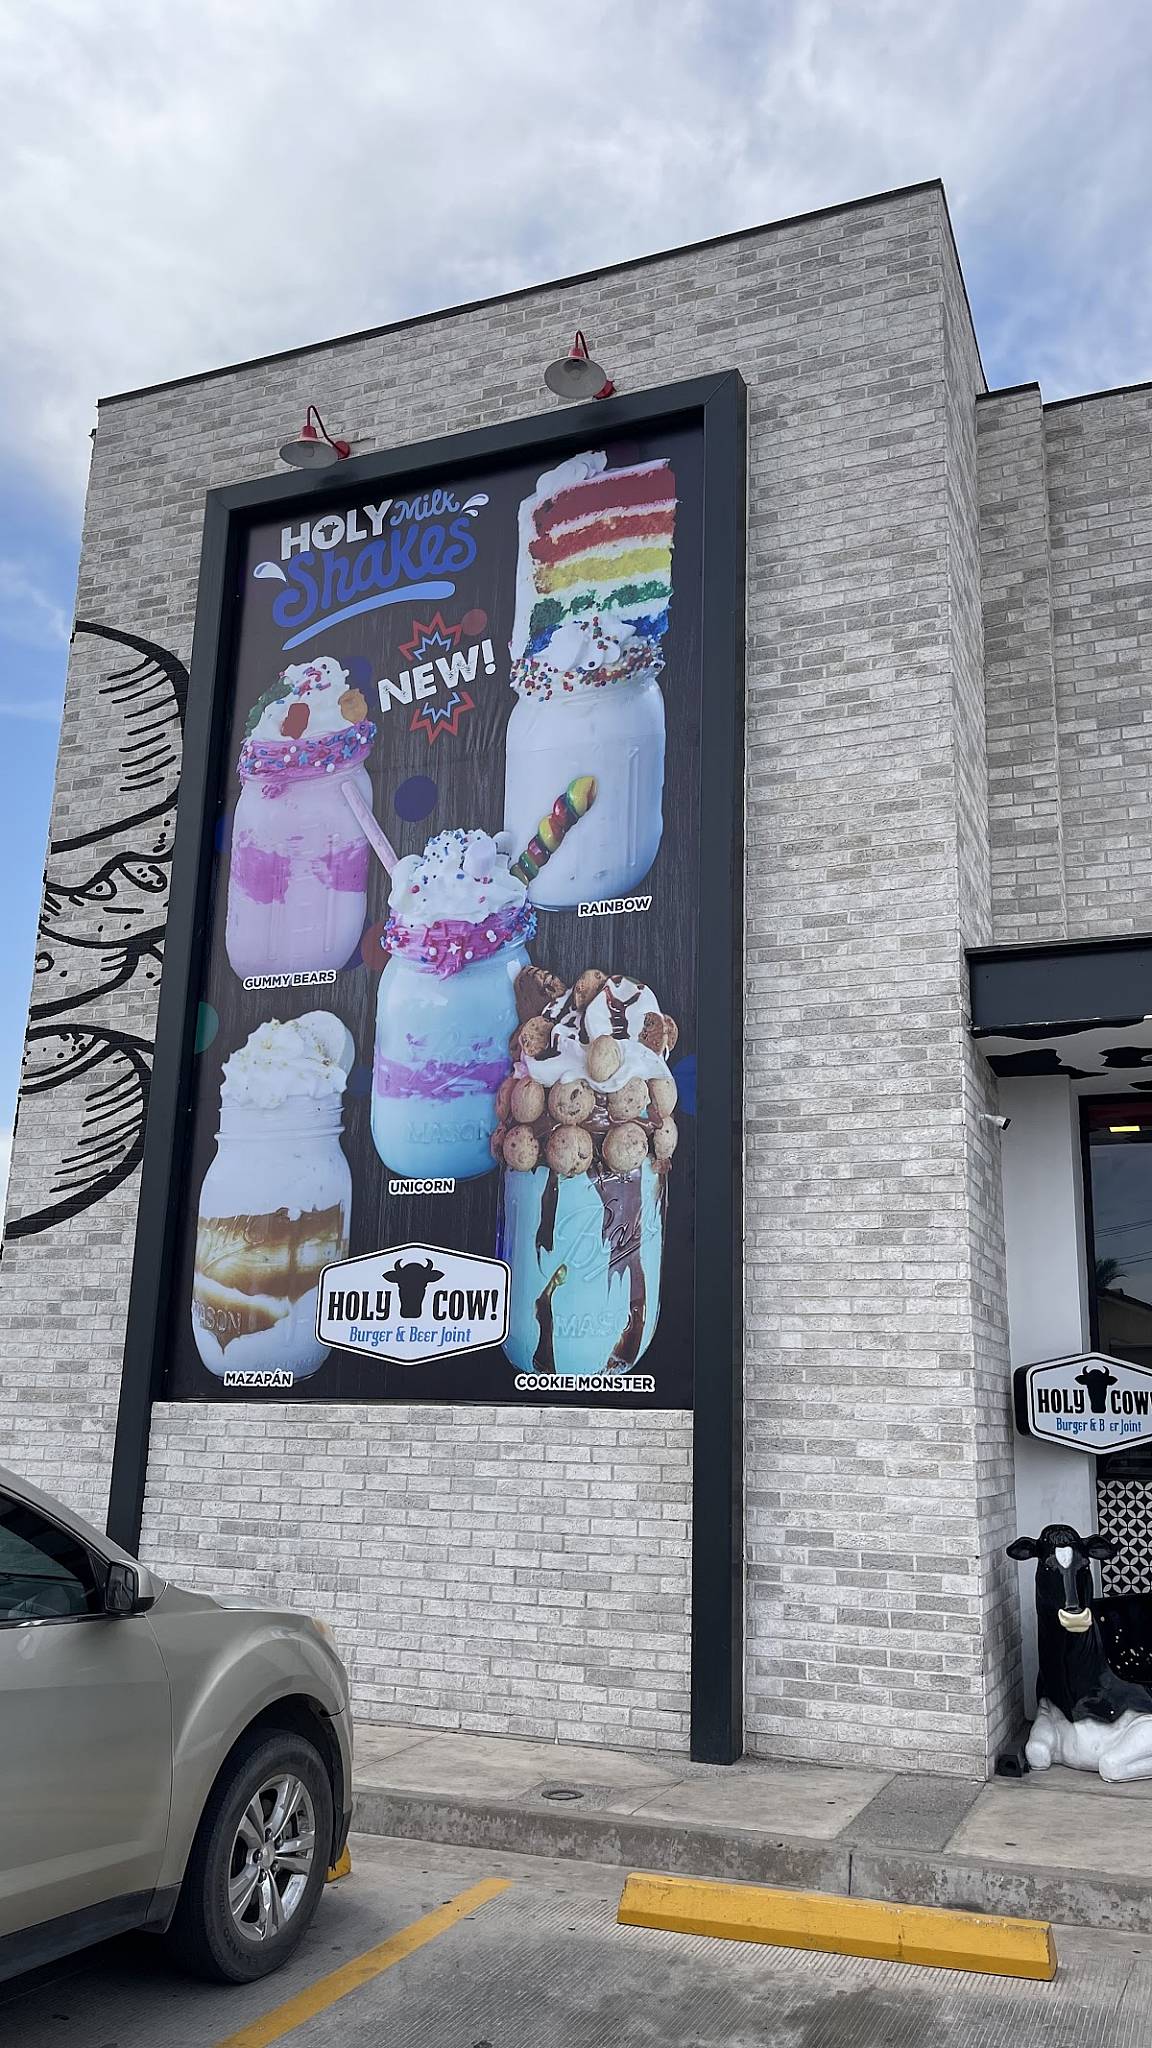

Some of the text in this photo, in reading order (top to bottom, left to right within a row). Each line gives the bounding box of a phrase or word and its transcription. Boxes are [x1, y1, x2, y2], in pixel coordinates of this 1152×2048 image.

[281, 488, 460, 560] HOLY Milk
[272, 516, 477, 628] Shakes
[377, 639, 497, 713] NEW!
[580, 897, 650, 915] RAINBOW
[244, 971, 335, 988] GUMMY BEARS
[390, 1180, 453, 1193] UNICORN
[327, 1289, 499, 1321] HOLY COW!
[350, 1326, 472, 1346] Burger & Beer Joint
[225, 1369, 292, 1386] MAZAPÁN
[516, 1376, 653, 1390] COOKIE MONSTER
[1037, 1388, 1085, 1414] HOLY
[1056, 1417, 1142, 1435] Burger & Ber Joint
